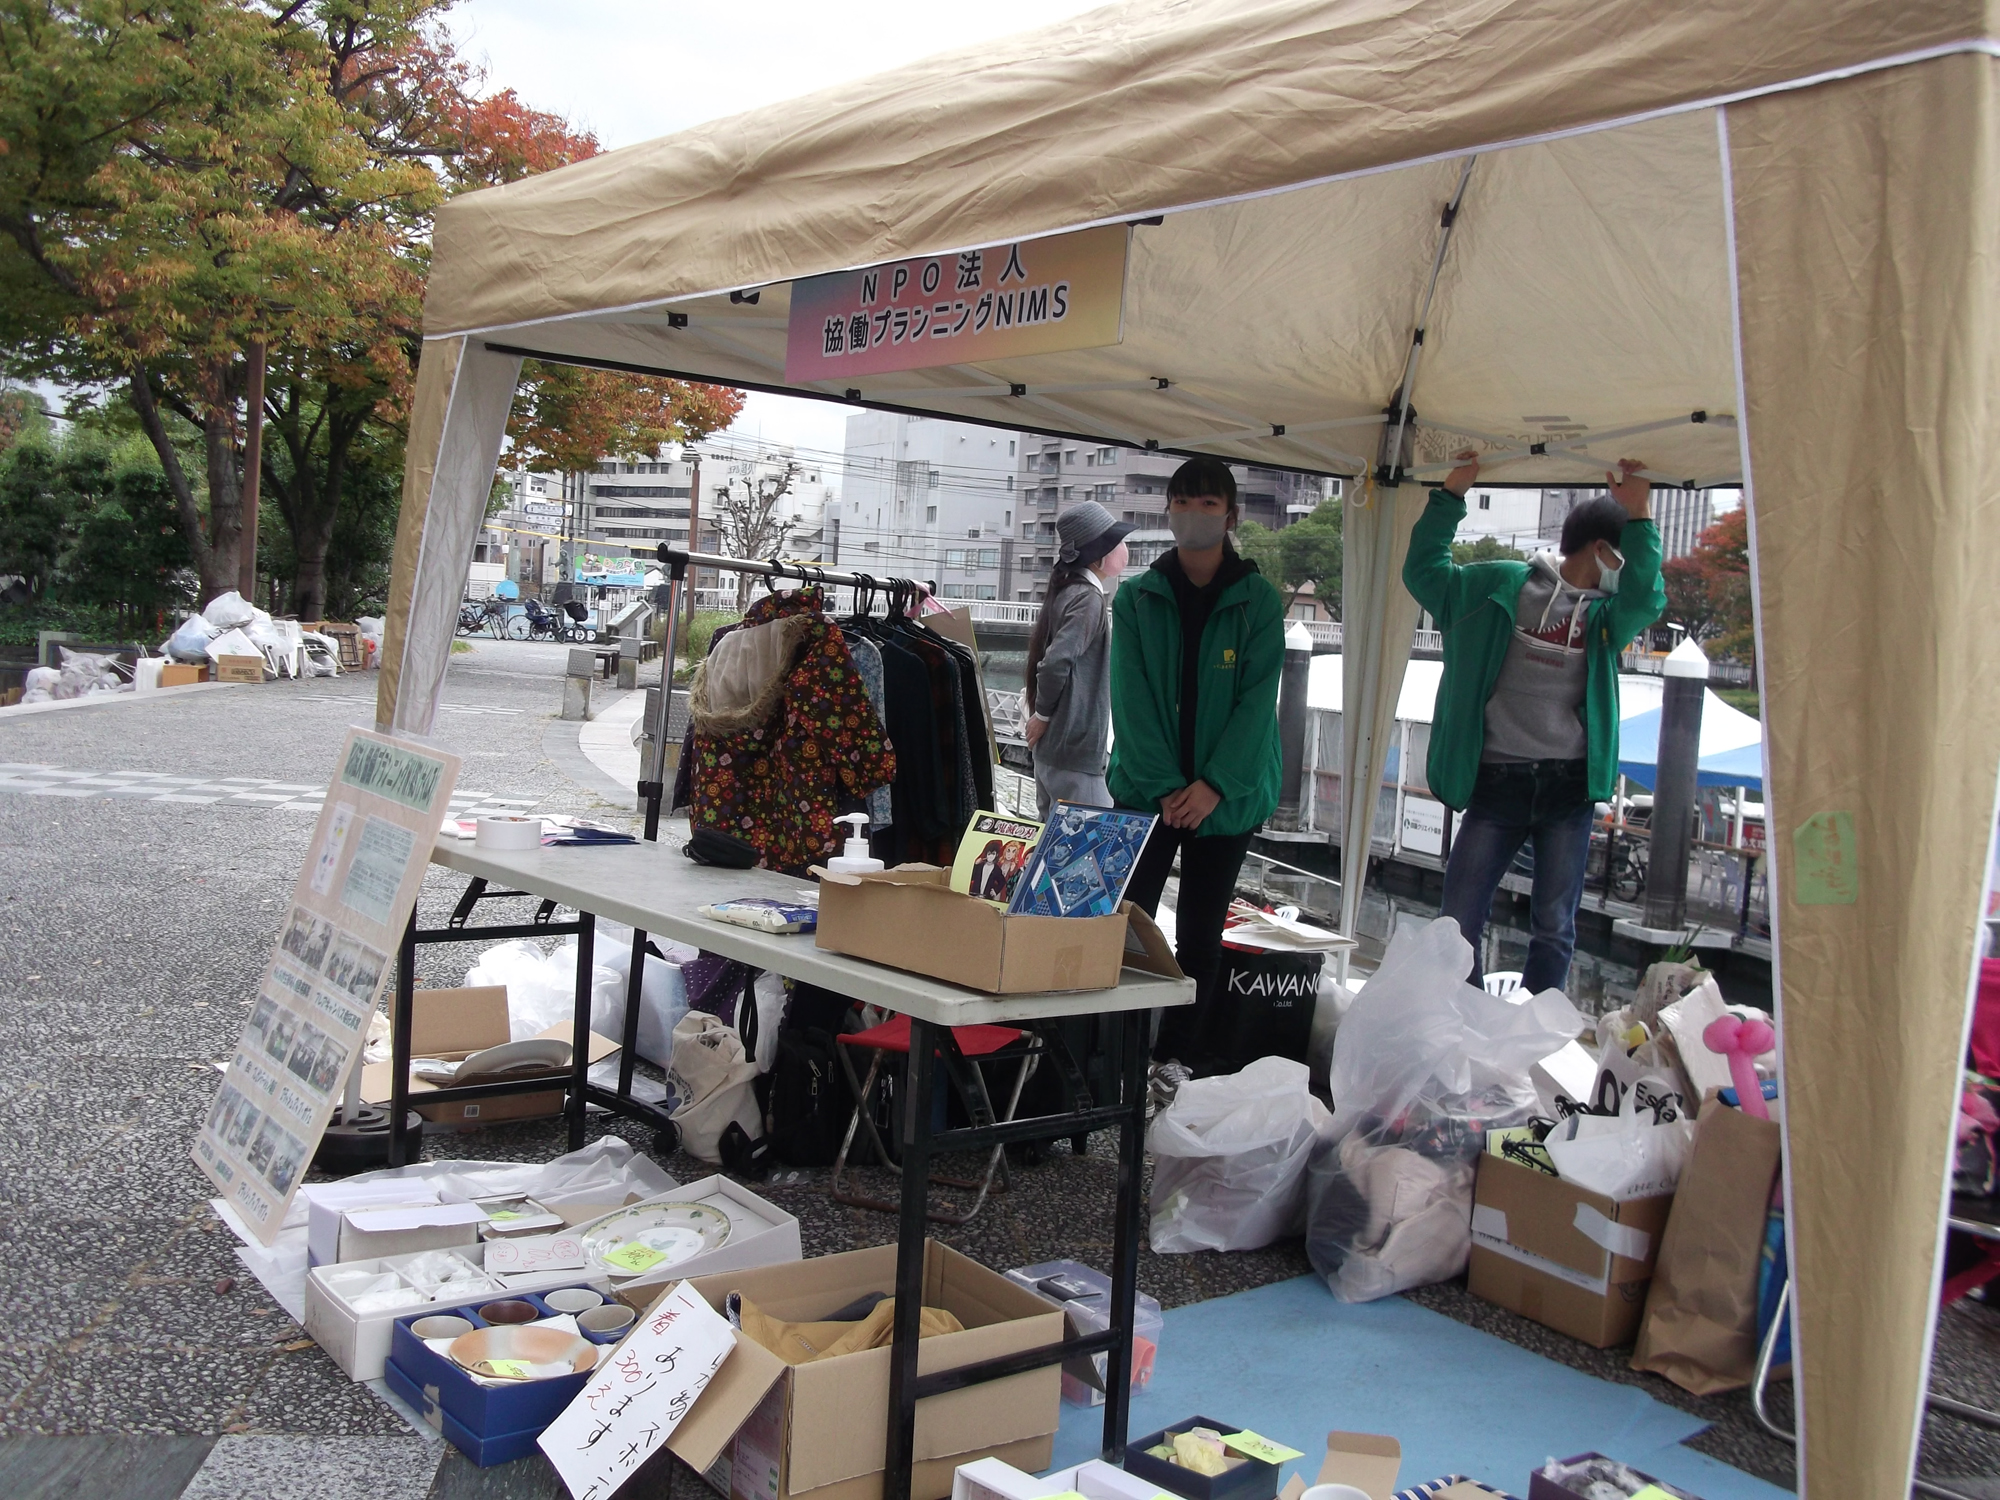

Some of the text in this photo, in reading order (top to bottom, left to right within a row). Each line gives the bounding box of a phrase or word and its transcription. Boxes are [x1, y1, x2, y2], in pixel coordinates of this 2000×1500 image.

[825, 286, 1068, 354] 協働プランニングNIMS
